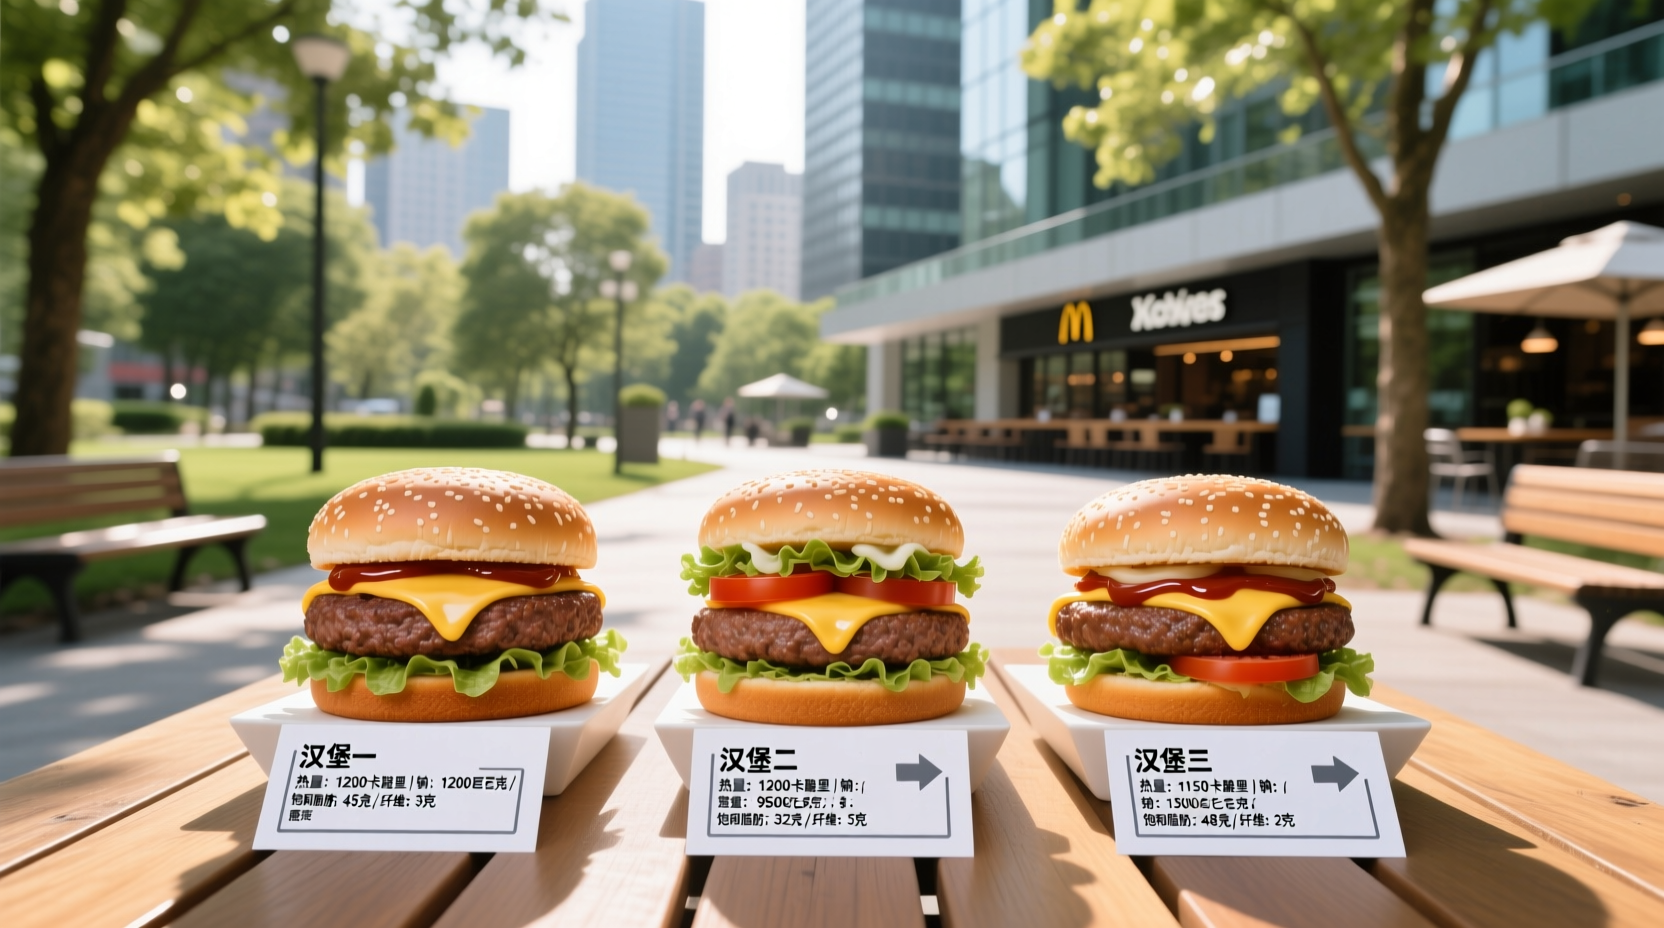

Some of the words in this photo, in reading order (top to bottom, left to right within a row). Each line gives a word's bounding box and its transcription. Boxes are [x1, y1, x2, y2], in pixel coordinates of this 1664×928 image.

[299, 743, 377, 769] 汉堡一
[719, 747, 798, 774] 汉堡二
[1134, 748, 1213, 774] 汉堡三
